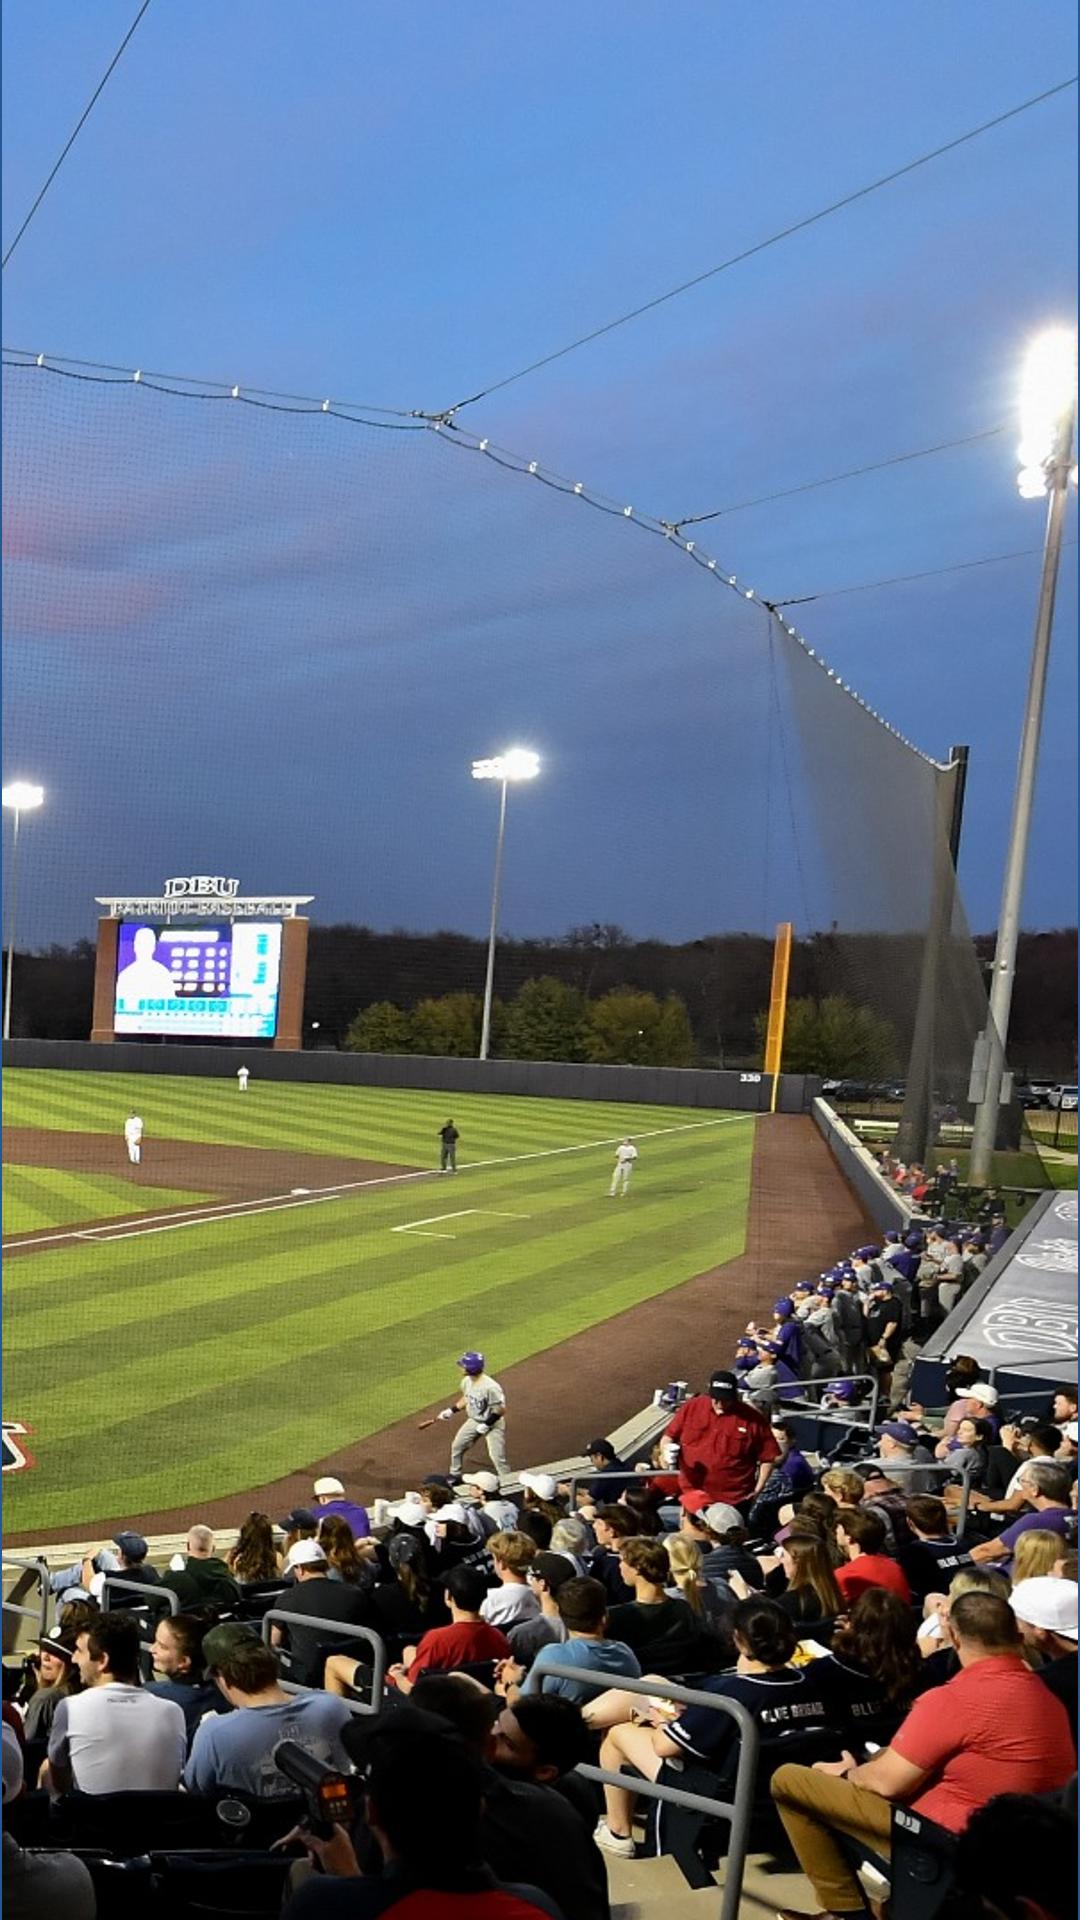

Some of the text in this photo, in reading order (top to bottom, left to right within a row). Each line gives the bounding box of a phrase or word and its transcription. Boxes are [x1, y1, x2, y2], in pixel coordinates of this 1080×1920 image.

[165, 876, 239, 897] DBU
[114, 900, 292, 916] PATRIOT BASEBALL
[740, 1073, 761, 1082] 330
